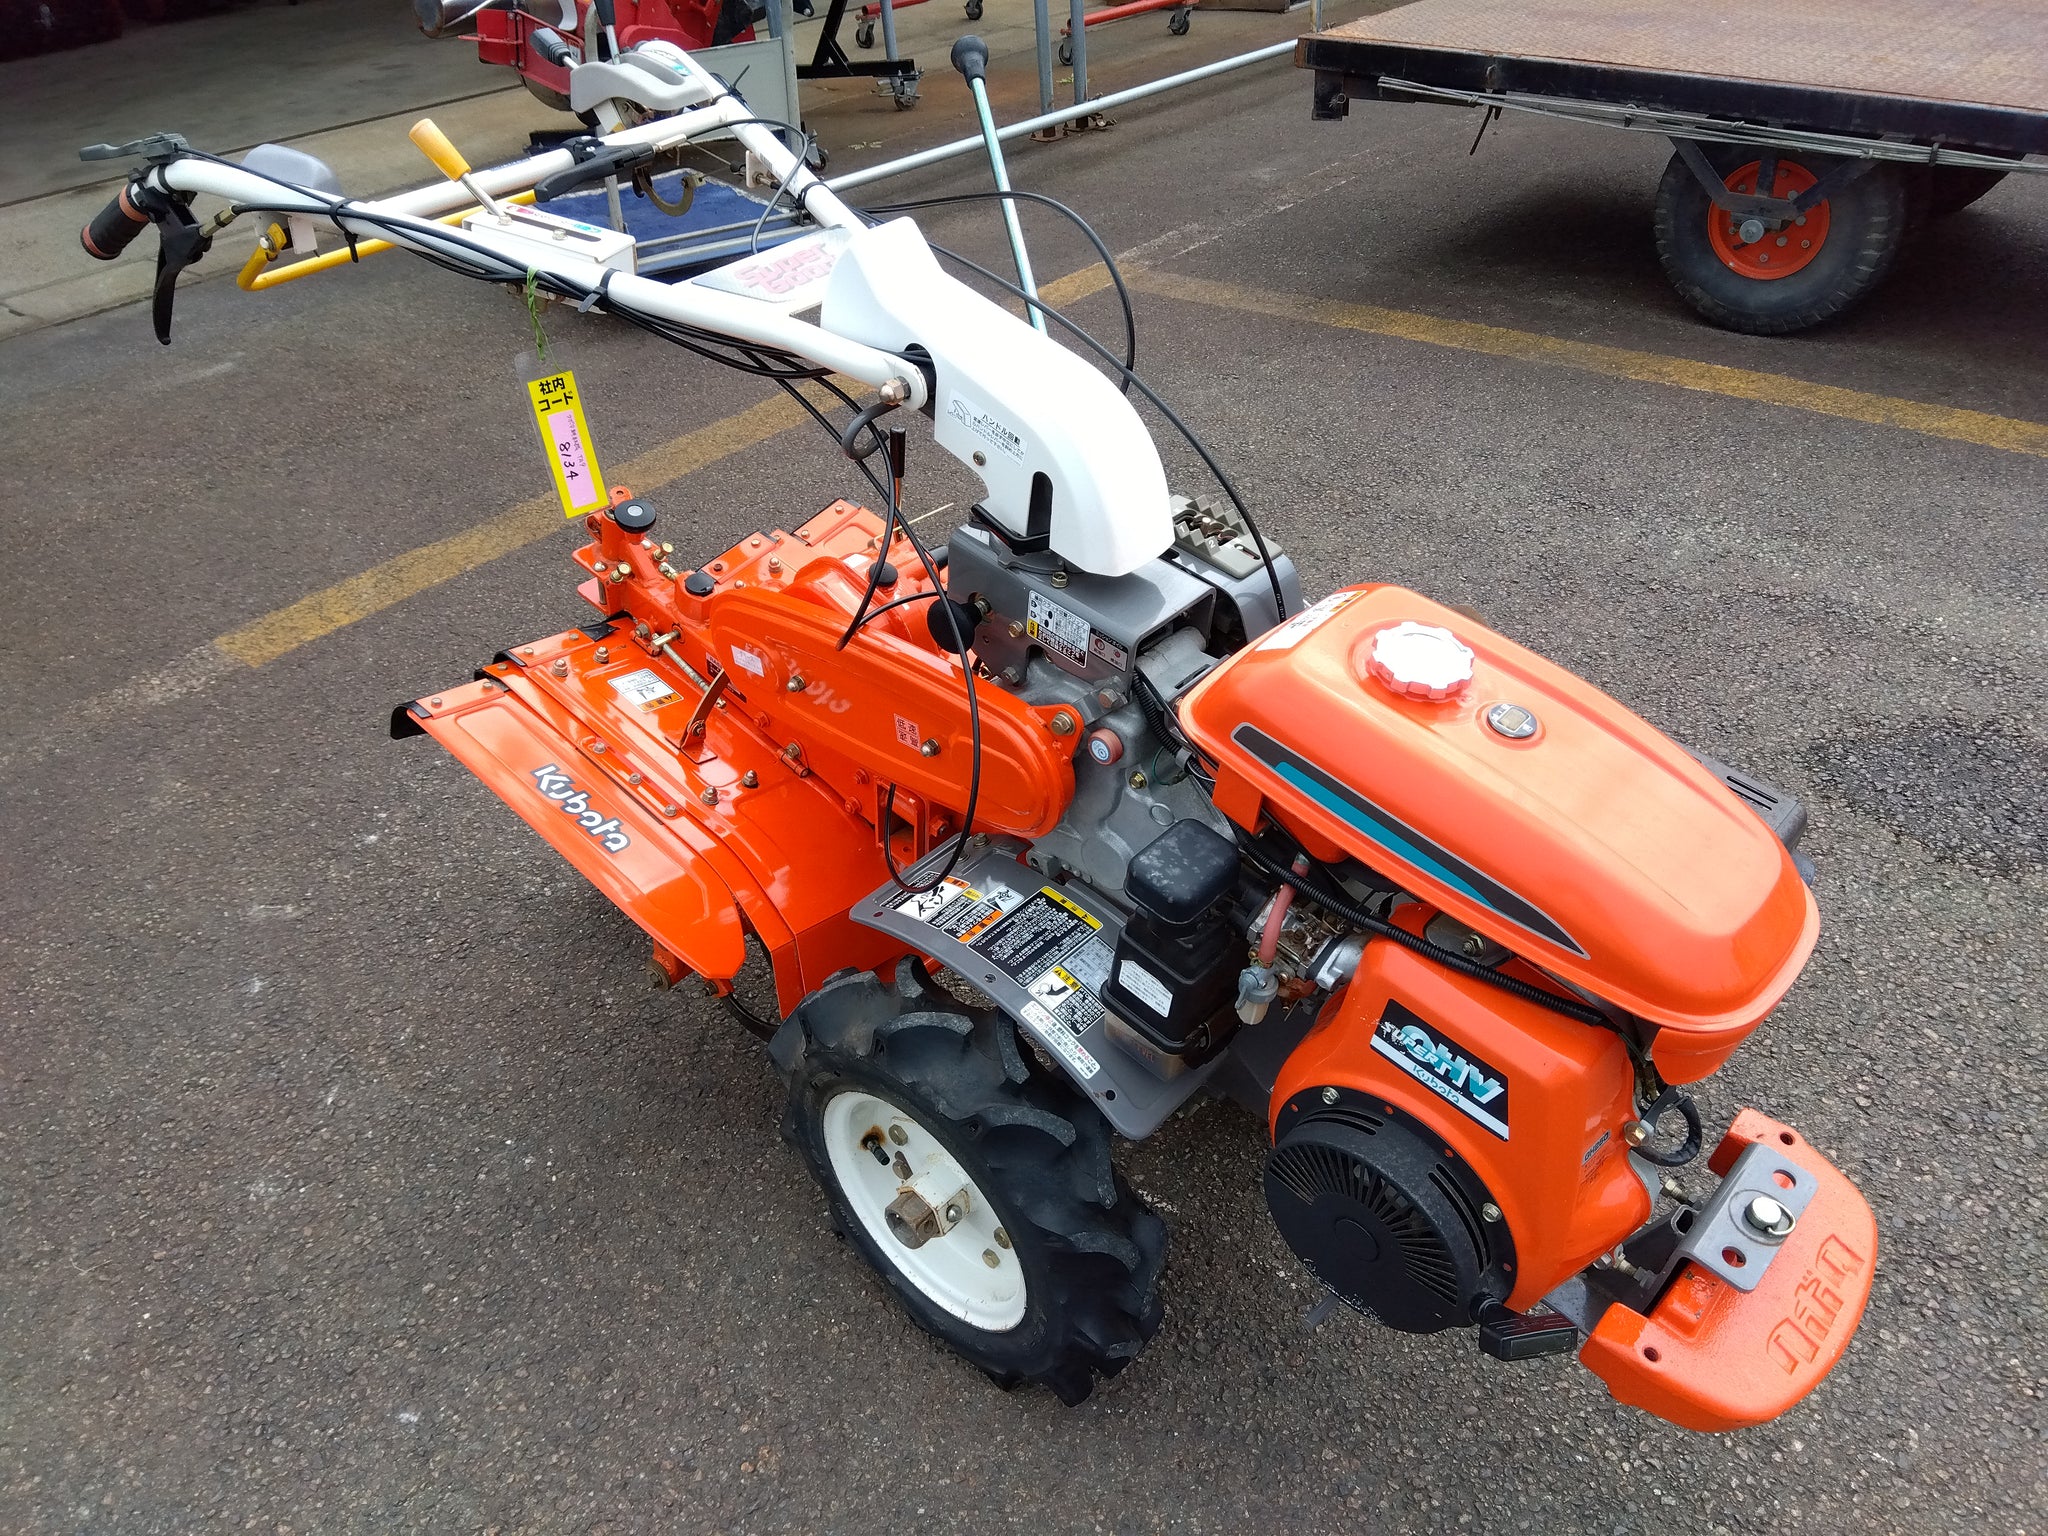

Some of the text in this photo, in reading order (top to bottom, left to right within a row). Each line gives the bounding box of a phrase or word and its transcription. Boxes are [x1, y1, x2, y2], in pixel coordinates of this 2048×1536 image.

[538, 391, 573, 412] コード
[539, 377, 566, 395] 社内
[558, 440, 579, 480] 8134
[1179, 525, 1186, 533] 1
[1208, 540, 1216, 549] 2
[530, 765, 632, 855] Kubota
[1381, 1021, 1439, 1065] SUPER
[1400, 1025, 1505, 1105] OHV
[1412, 1064, 1460, 1104] Kubota
[1766, 1233, 1866, 1376] クボタ
